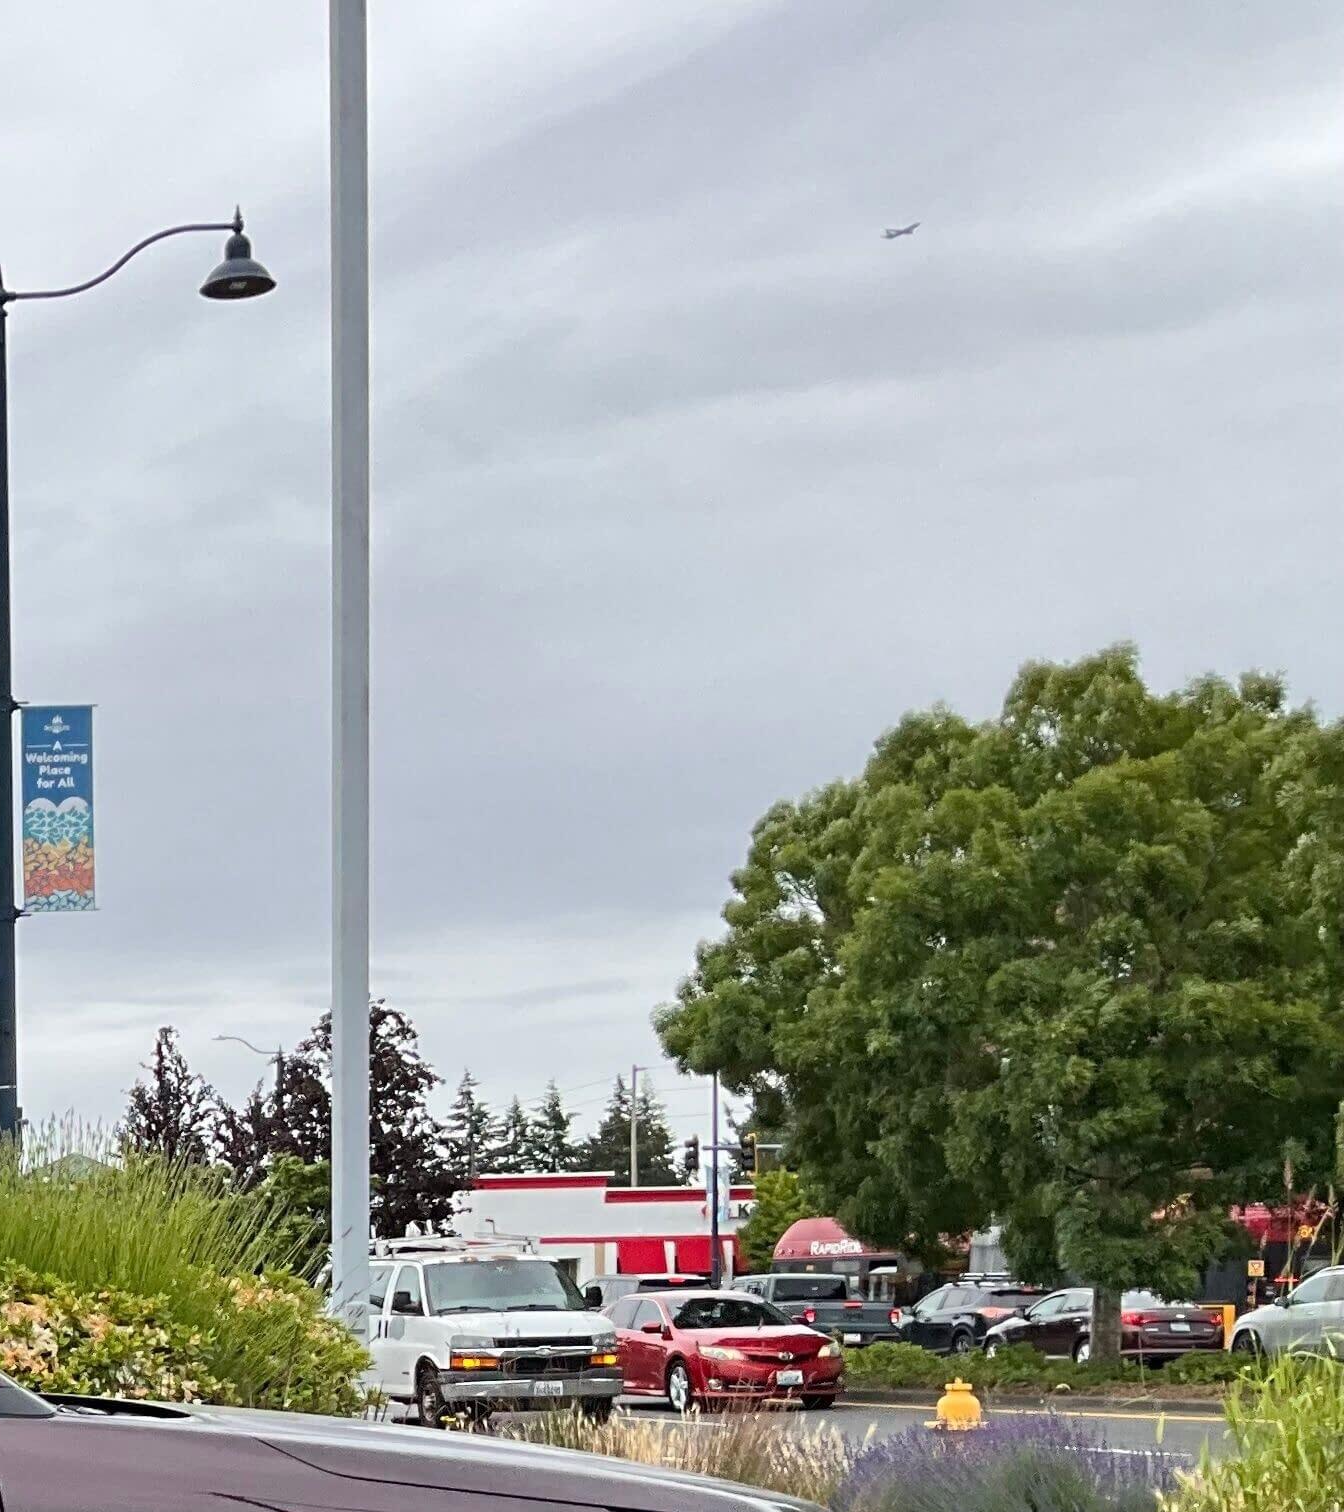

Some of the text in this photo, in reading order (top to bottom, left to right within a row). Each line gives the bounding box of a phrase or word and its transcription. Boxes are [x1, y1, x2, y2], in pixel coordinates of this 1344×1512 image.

[53, 740, 62, 751] A
[25, 751, 88, 764] Welcoming
[39, 765, 71, 775] Place
[37, 776, 75, 789] for All
